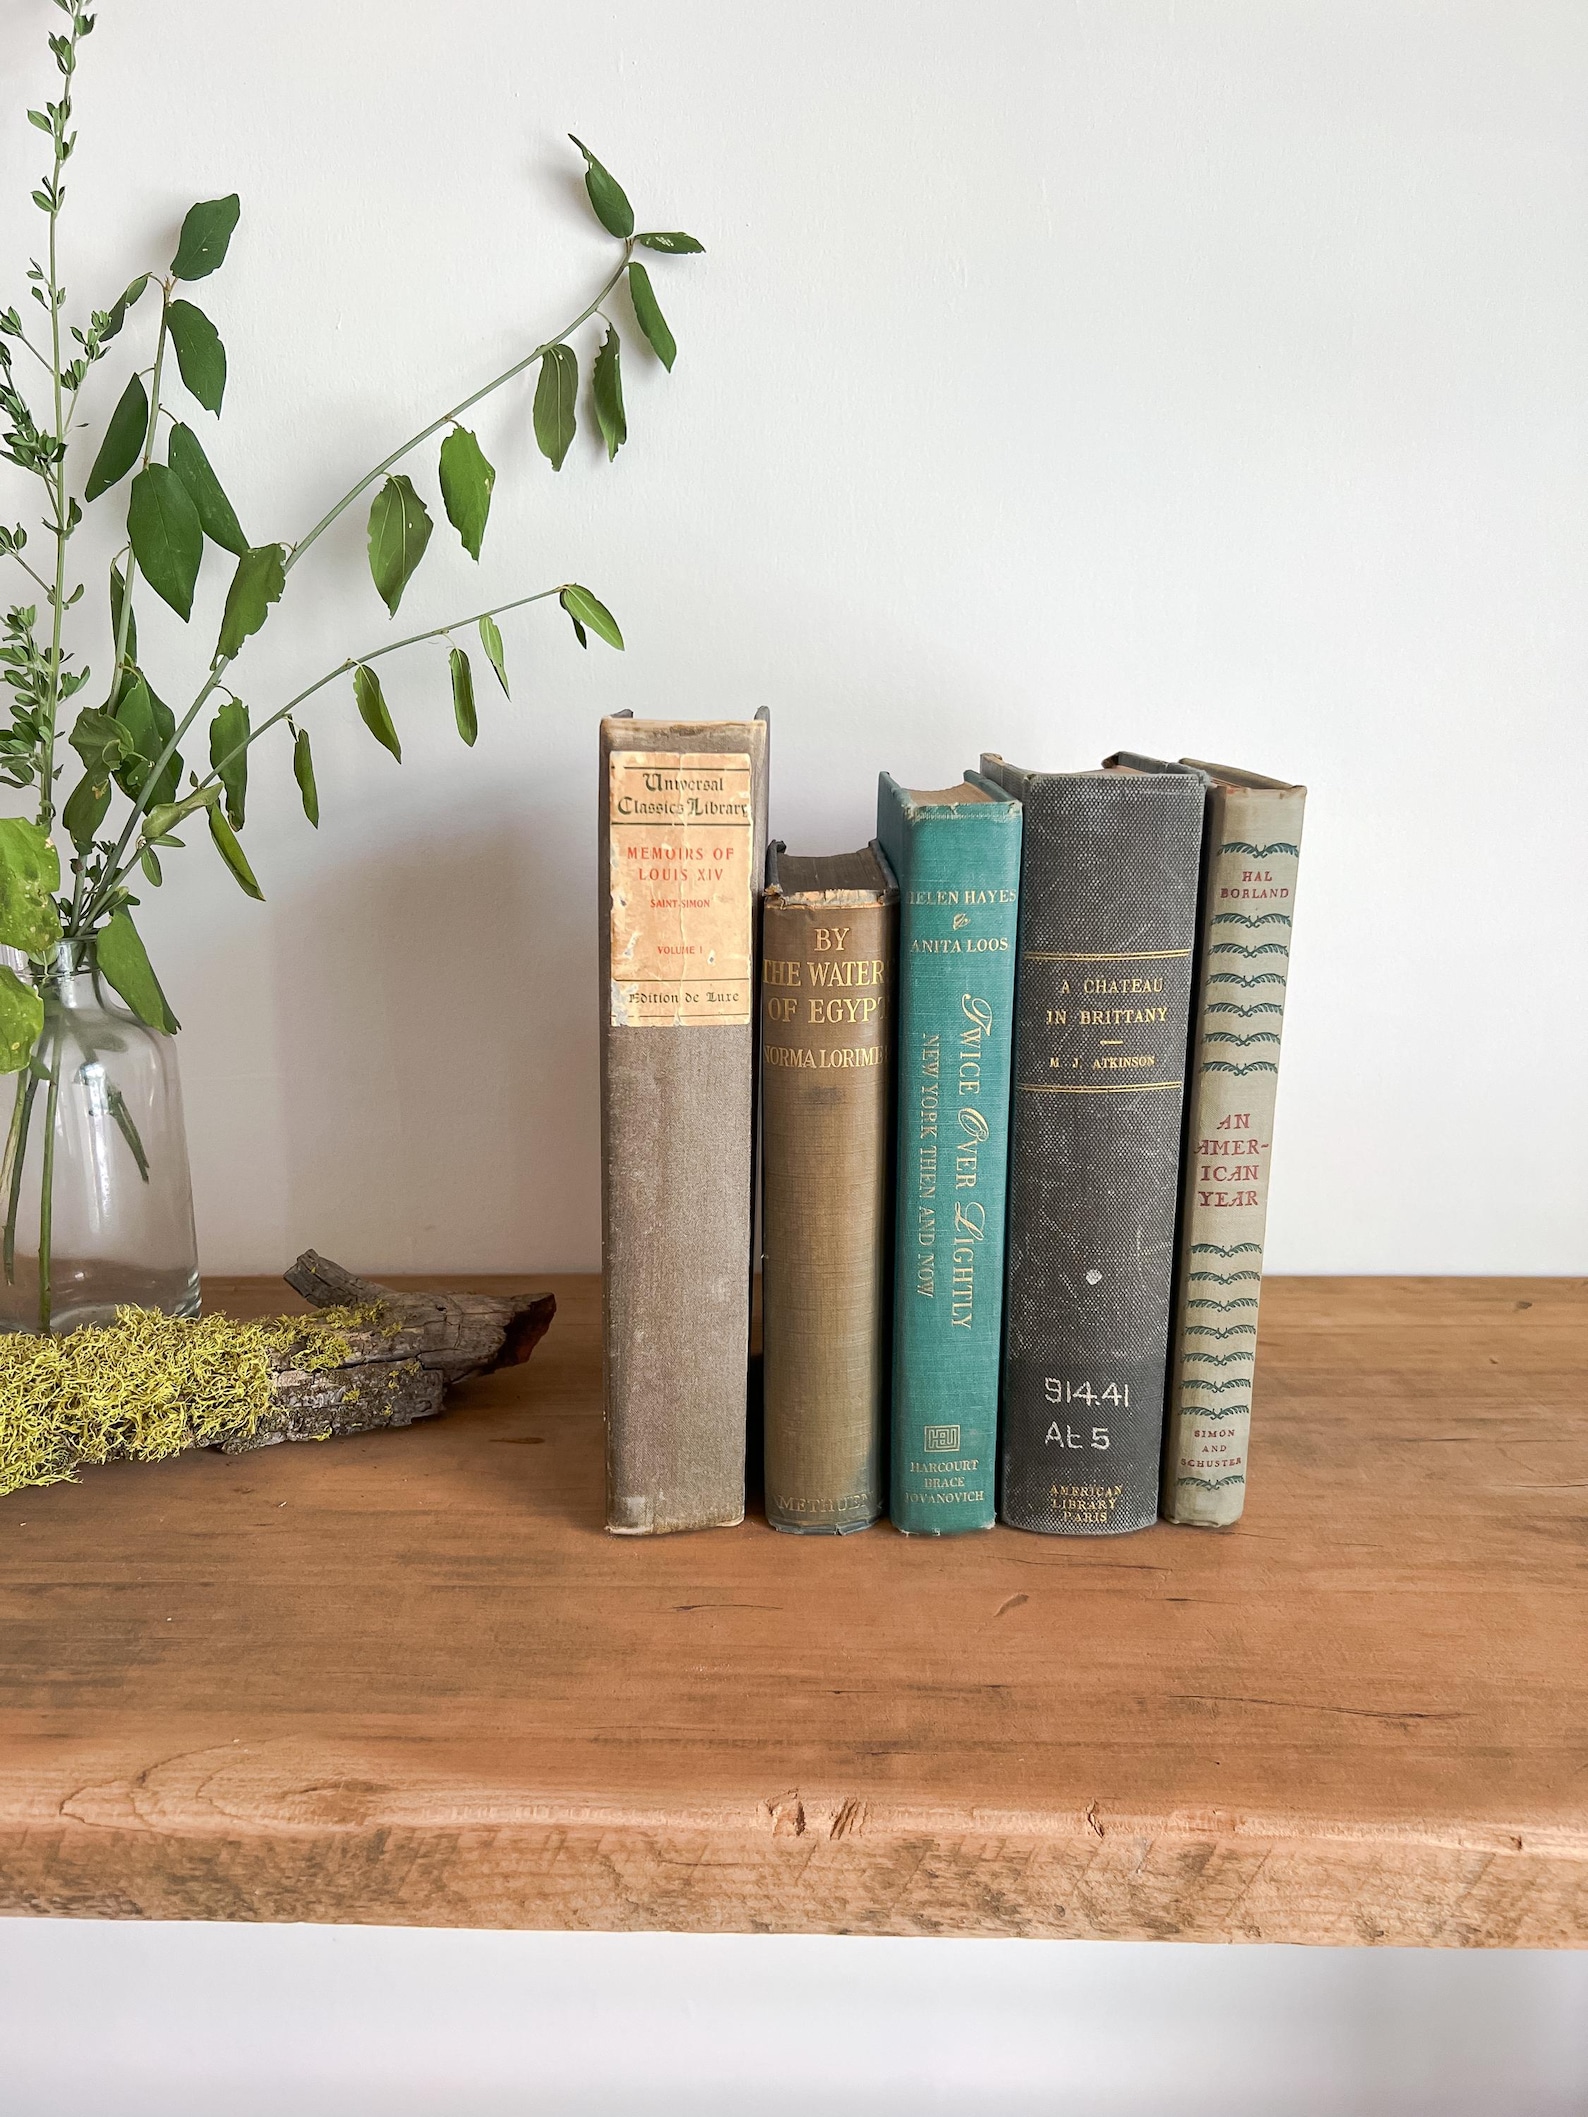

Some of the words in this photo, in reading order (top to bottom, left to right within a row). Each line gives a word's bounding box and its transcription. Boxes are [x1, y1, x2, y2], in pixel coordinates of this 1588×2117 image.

[643, 773, 724, 791] Universal
[617, 797, 684, 815] Classics
[686, 797, 748, 817] Library
[627, 846, 703, 860] MEMOIRS
[713, 847, 734, 860] OF
[638, 868, 688, 881] LOUIS
[697, 868, 724, 880] XIV
[1242, 871, 1273, 881] HAL
[964, 889, 1016, 904] HAYES
[1220, 888, 1289, 899] BORLAND
[650, 899, 711, 908] SAINT-SIMON
[814, 928, 850, 951] BY
[910, 939, 963, 953] ANITA
[966, 937, 1009, 952] LOOS
[763, 960, 802, 987] THE
[1061, 979, 1071, 994] A
[1084, 978, 1163, 994] CHATEAU
[685, 992, 700, 1003] de
[705, 991, 740, 1003] Luxe
[768, 997, 798, 1023] OF
[1046, 1010, 1067, 1025] IN
[1080, 1007, 1168, 1025] BRITTANY
[958, 993, 993, 1096] TWICE
[763, 1045, 817, 1069] NORMA
[819, 1045, 890, 1069] LORIME
[921, 1033, 940, 1079] NEW
[1092, 1056, 1156, 1070] ATKINSON
[920, 1083, 940, 1139] YORK
[1216, 1114, 1251, 1130] AN
[955, 1107, 990, 1189] OVER
[1193, 1139, 1270, 1156] AMER-
[918, 1146, 937, 1199] THEN
[1200, 1165, 1260, 1182] ICAN
[1198, 1190, 1258, 1207] YEAR
[918, 1206, 936, 1246] AND
[951, 1201, 986, 1329] LIGHTLY
[917, 1253, 935, 1298] NOW
[1194, 1429, 1236, 1438] SIMON
[1201, 1445, 1227, 1453] AND
[910, 1460, 980, 1473] HARCOURT
[1180, 1457, 1242, 1468] SCHUSTER
[924, 1477, 965, 1489] BRACE
[1050, 1484, 1124, 1497] AMERICAN
[1051, 1499, 1118, 1511] LIBRARY
[1063, 1511, 1108, 1524] PARIS
